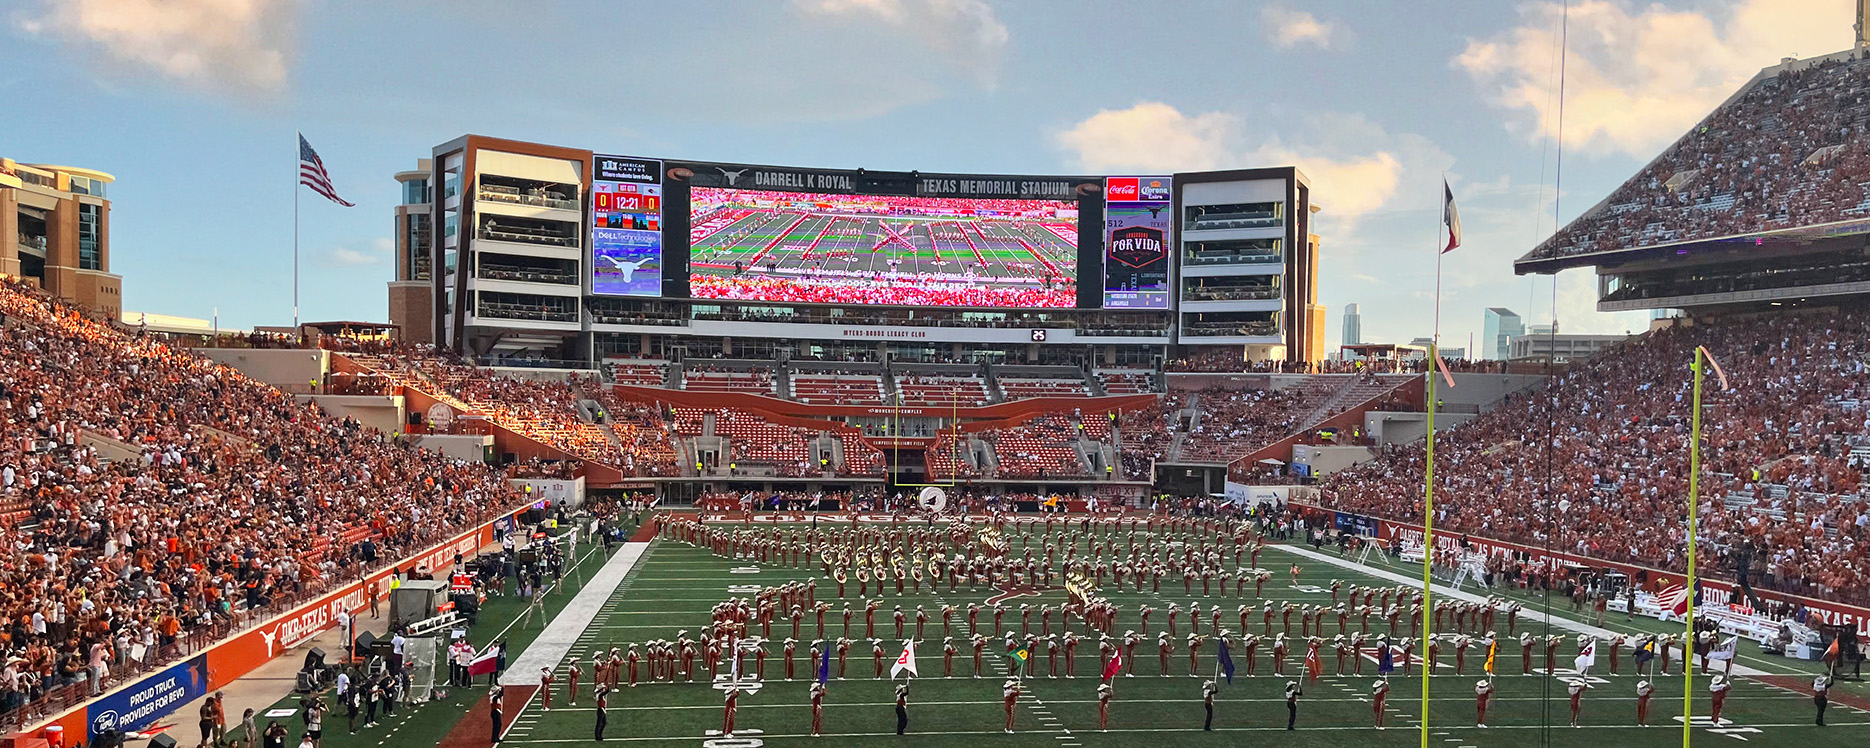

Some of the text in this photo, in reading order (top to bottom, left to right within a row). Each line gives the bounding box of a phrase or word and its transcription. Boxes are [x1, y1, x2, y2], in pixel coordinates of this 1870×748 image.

[755, 171, 851, 189] DARRELL K ROYAL
[922, 179, 1070, 196] TEXAS MEMORIAL STADIUM
[1141, 186, 1168, 195] Corona
[600, 194, 607, 207] 0
[616, 196, 638, 210] 12:21
[648, 197, 655, 210] 0
[1108, 219, 1123, 228] 512
[1113, 238, 1161, 252] POR VIDA
[1099, 486, 1122, 495] BEVO
[130, 677, 176, 707] PROUD TRUCK
[119, 686, 185, 728] PROVIDER FOR BEVO
